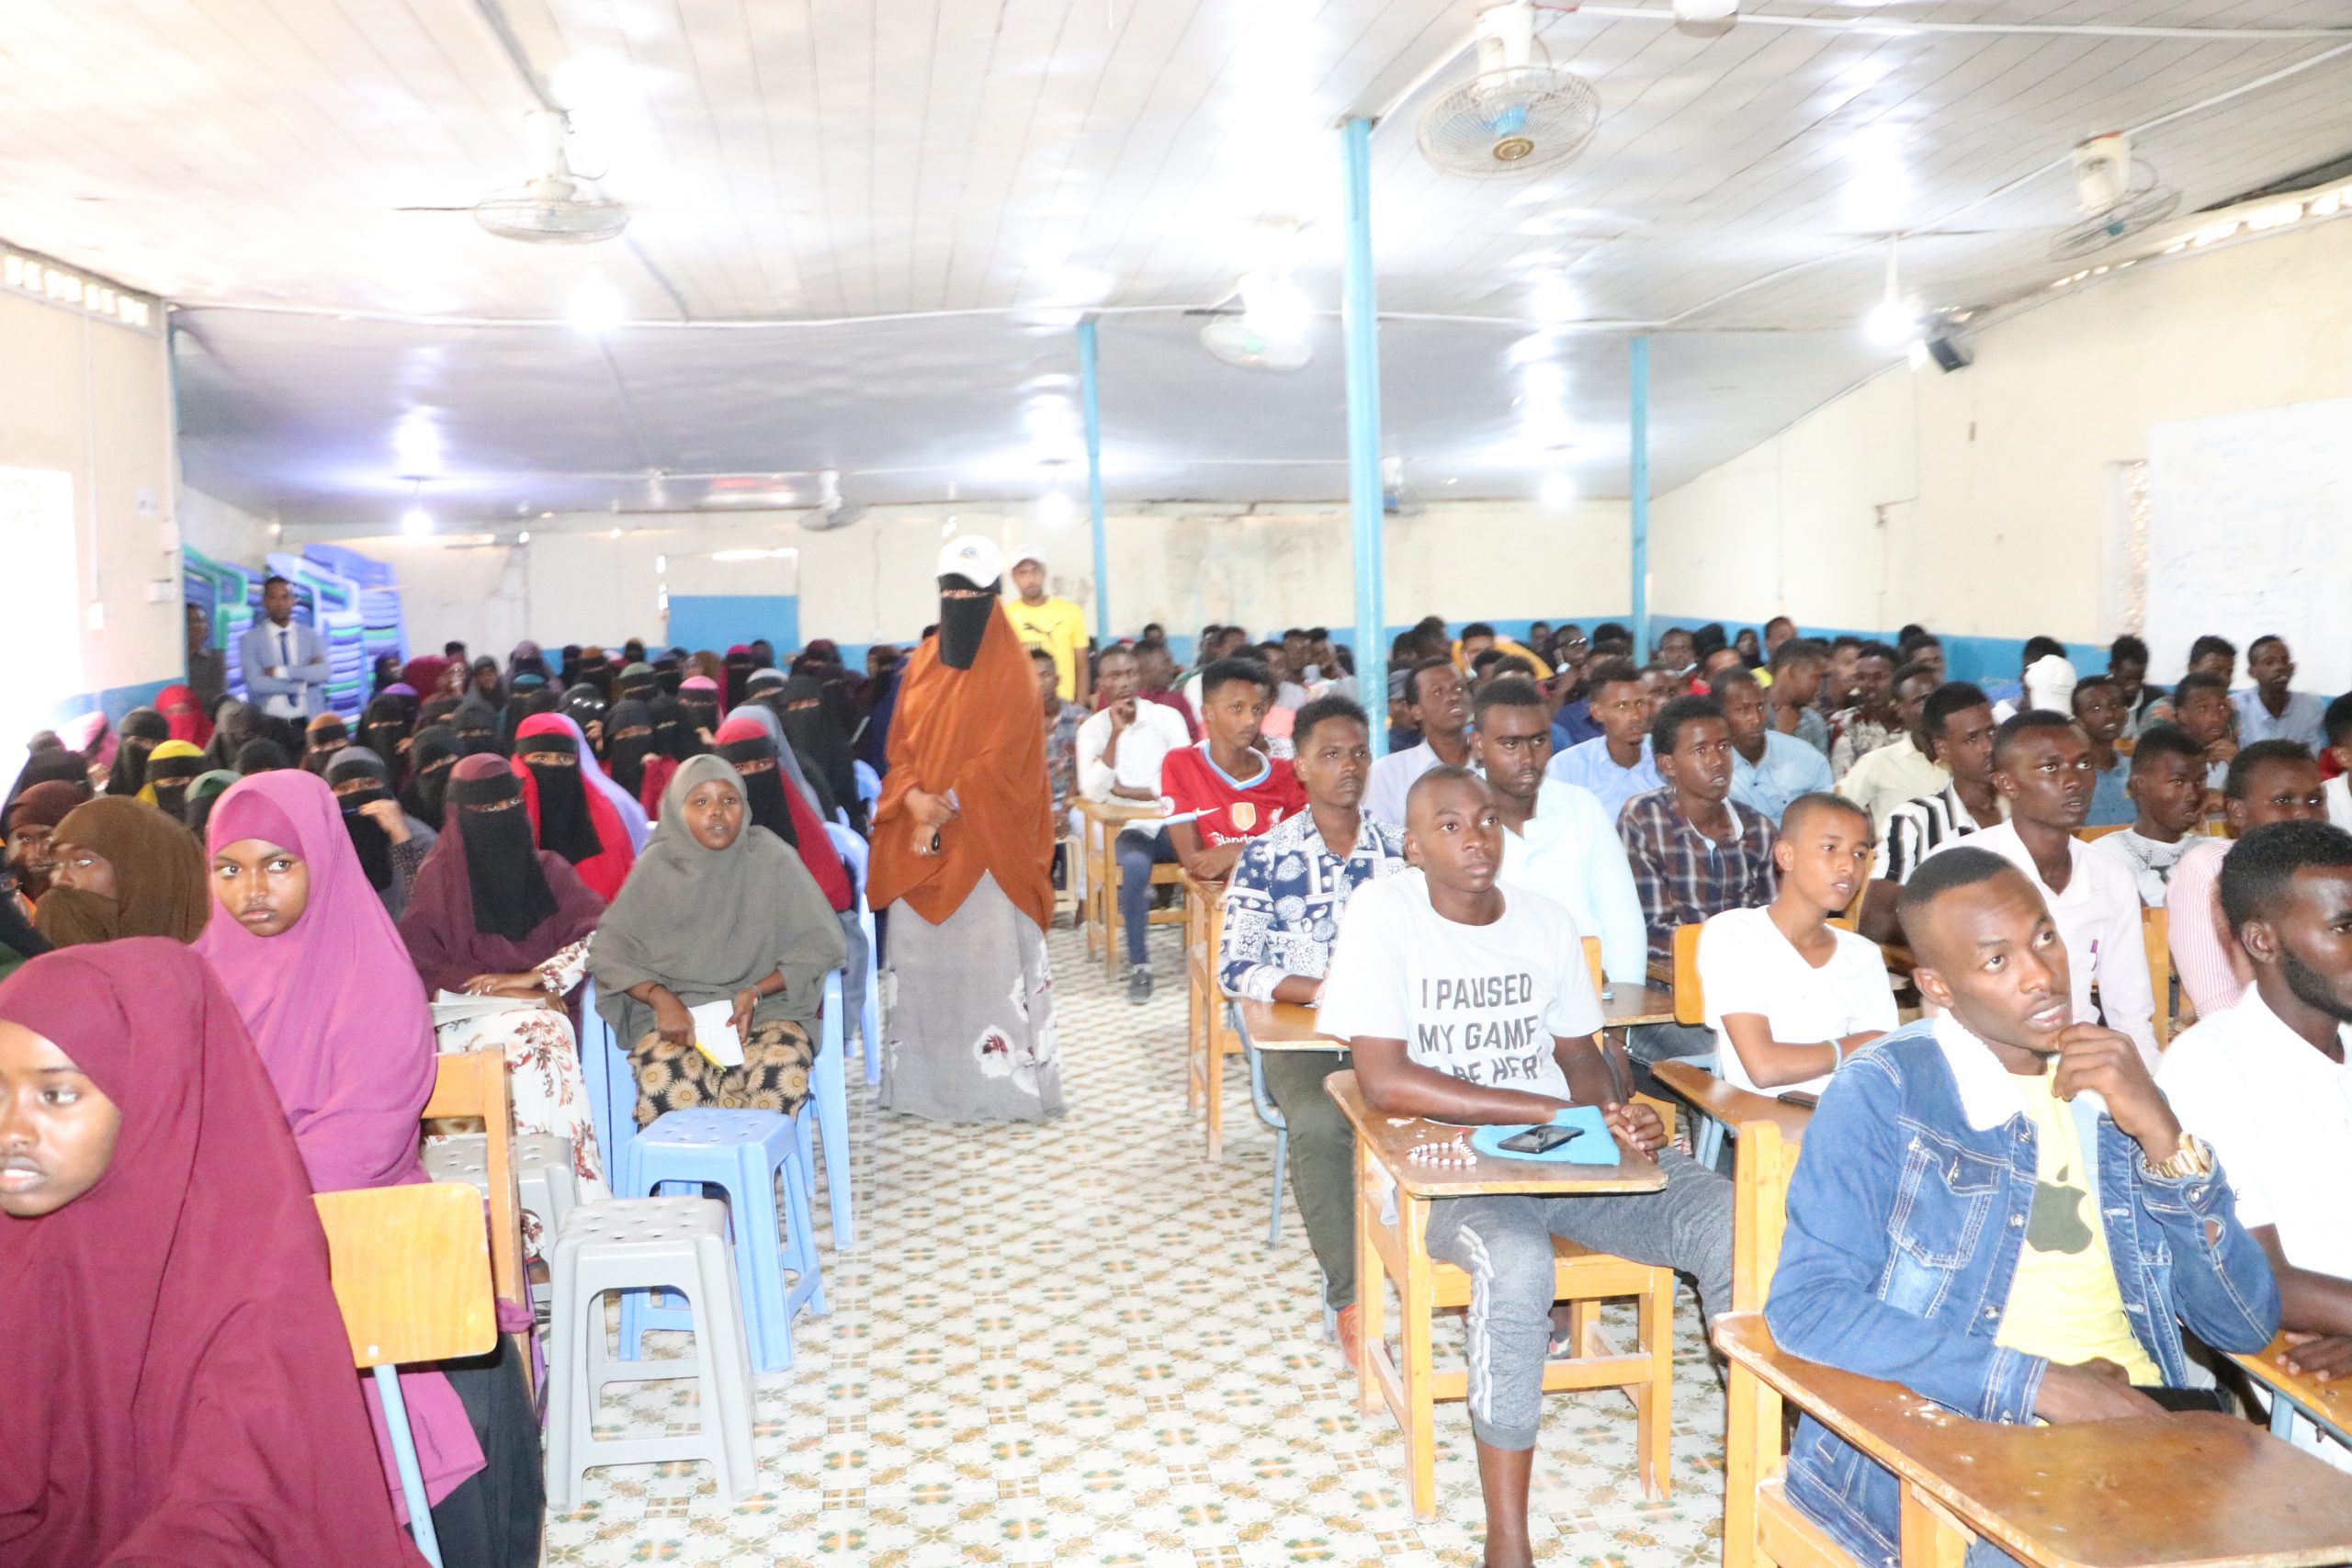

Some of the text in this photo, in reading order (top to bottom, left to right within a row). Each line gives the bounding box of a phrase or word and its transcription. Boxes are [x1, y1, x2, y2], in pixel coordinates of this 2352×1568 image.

[1422, 973, 1532, 1010] I PAUSED
[1418, 1022, 1455, 1055] MY
